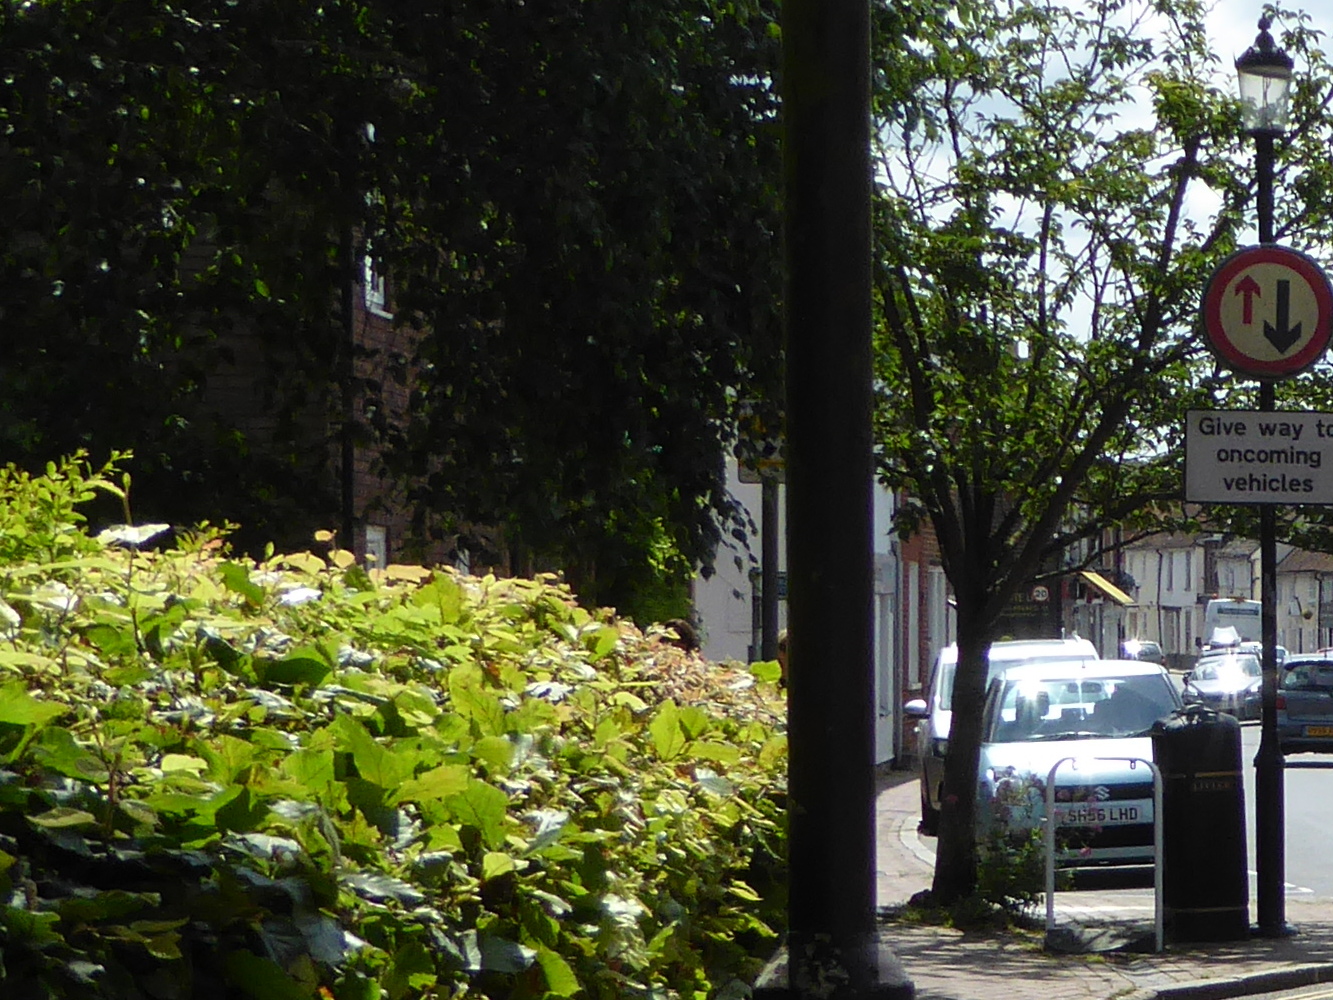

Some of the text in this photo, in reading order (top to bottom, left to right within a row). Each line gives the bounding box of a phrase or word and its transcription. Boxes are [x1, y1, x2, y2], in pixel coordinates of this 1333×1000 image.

[1198, 417, 1247, 436] Give
[1258, 421, 1304, 441] way
[1216, 446, 1322, 468] oncoming
[1223, 473, 1314, 493] vehicles
[1110, 807, 1138, 821] LHD
